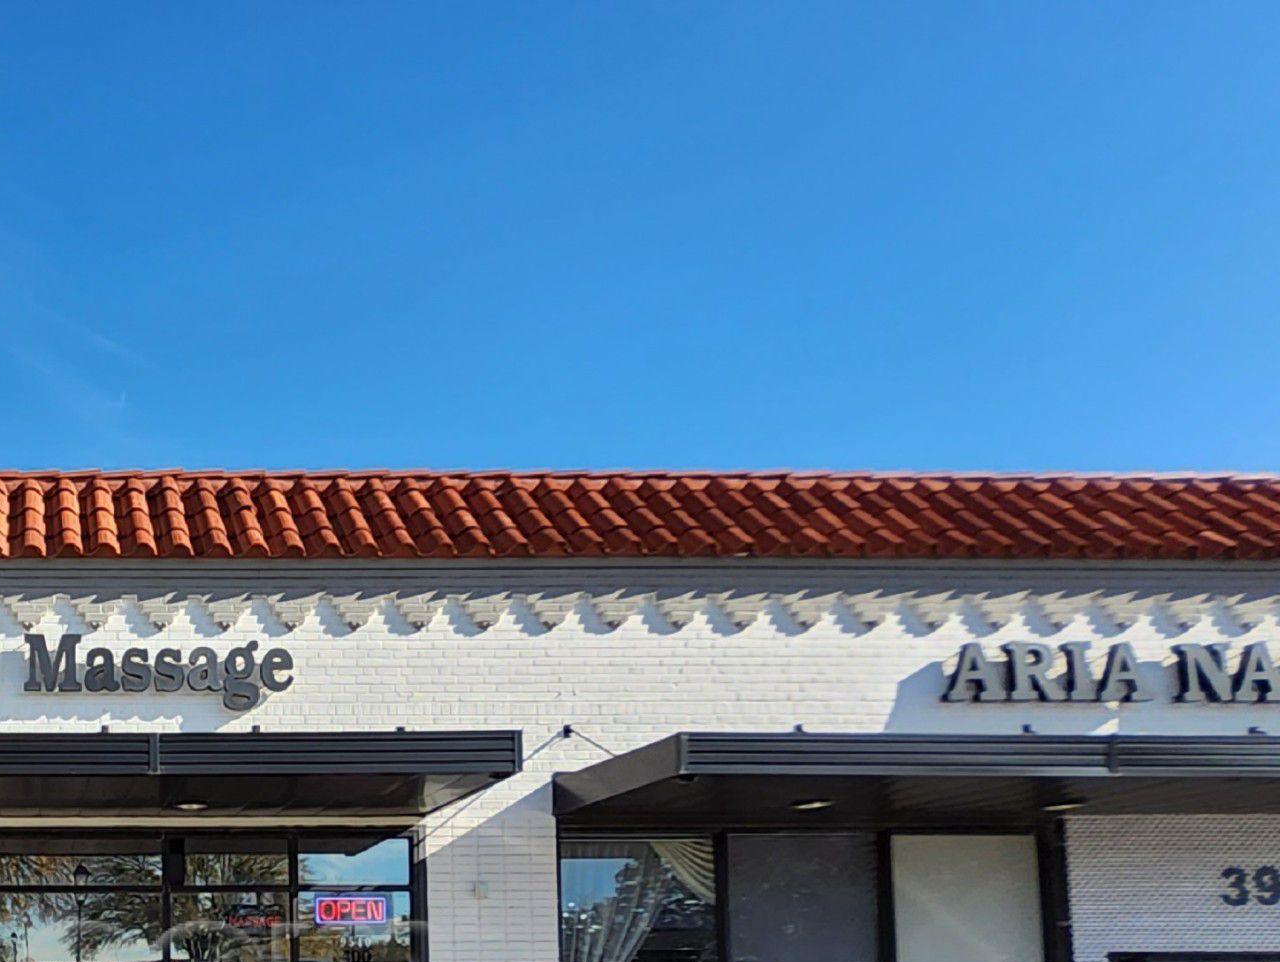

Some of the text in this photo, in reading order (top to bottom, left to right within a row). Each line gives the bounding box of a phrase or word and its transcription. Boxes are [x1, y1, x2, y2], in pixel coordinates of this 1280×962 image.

[24, 633, 295, 712] Massage
[939, 640, 1153, 702] ARIA
[319, 900, 385, 922] OPEN
[1221, 865, 1280, 906] 39
